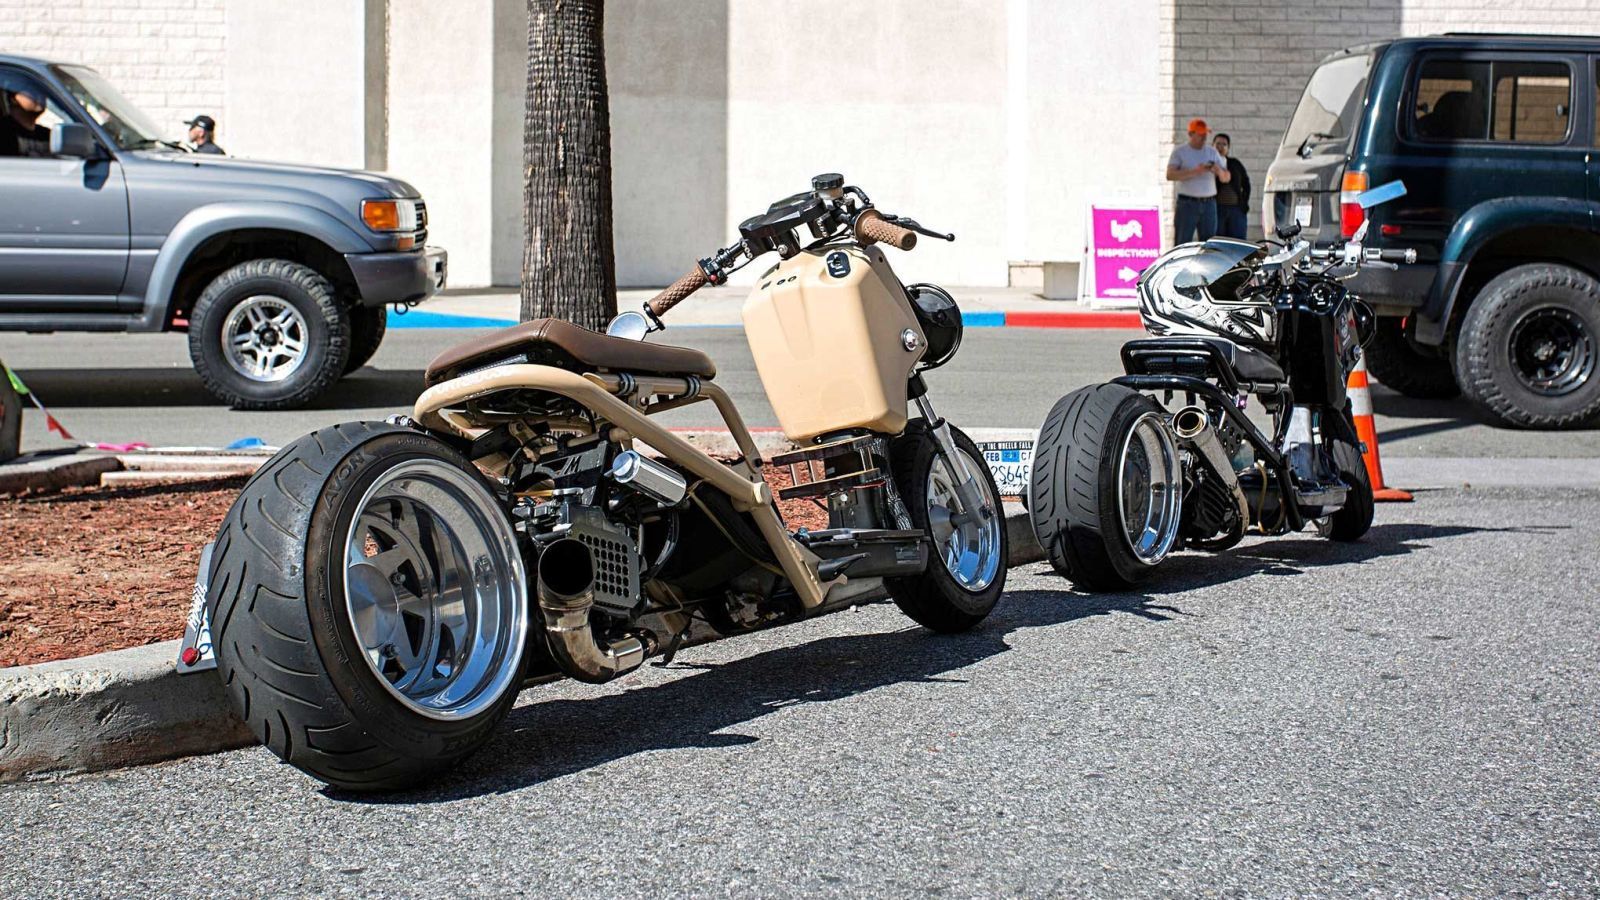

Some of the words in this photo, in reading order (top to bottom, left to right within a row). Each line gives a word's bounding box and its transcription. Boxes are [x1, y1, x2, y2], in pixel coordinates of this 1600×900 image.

[1096, 248, 1159, 258] INSPECTIONS
[985, 452, 1000, 461] FEB
[322, 450, 367, 510] AVON
